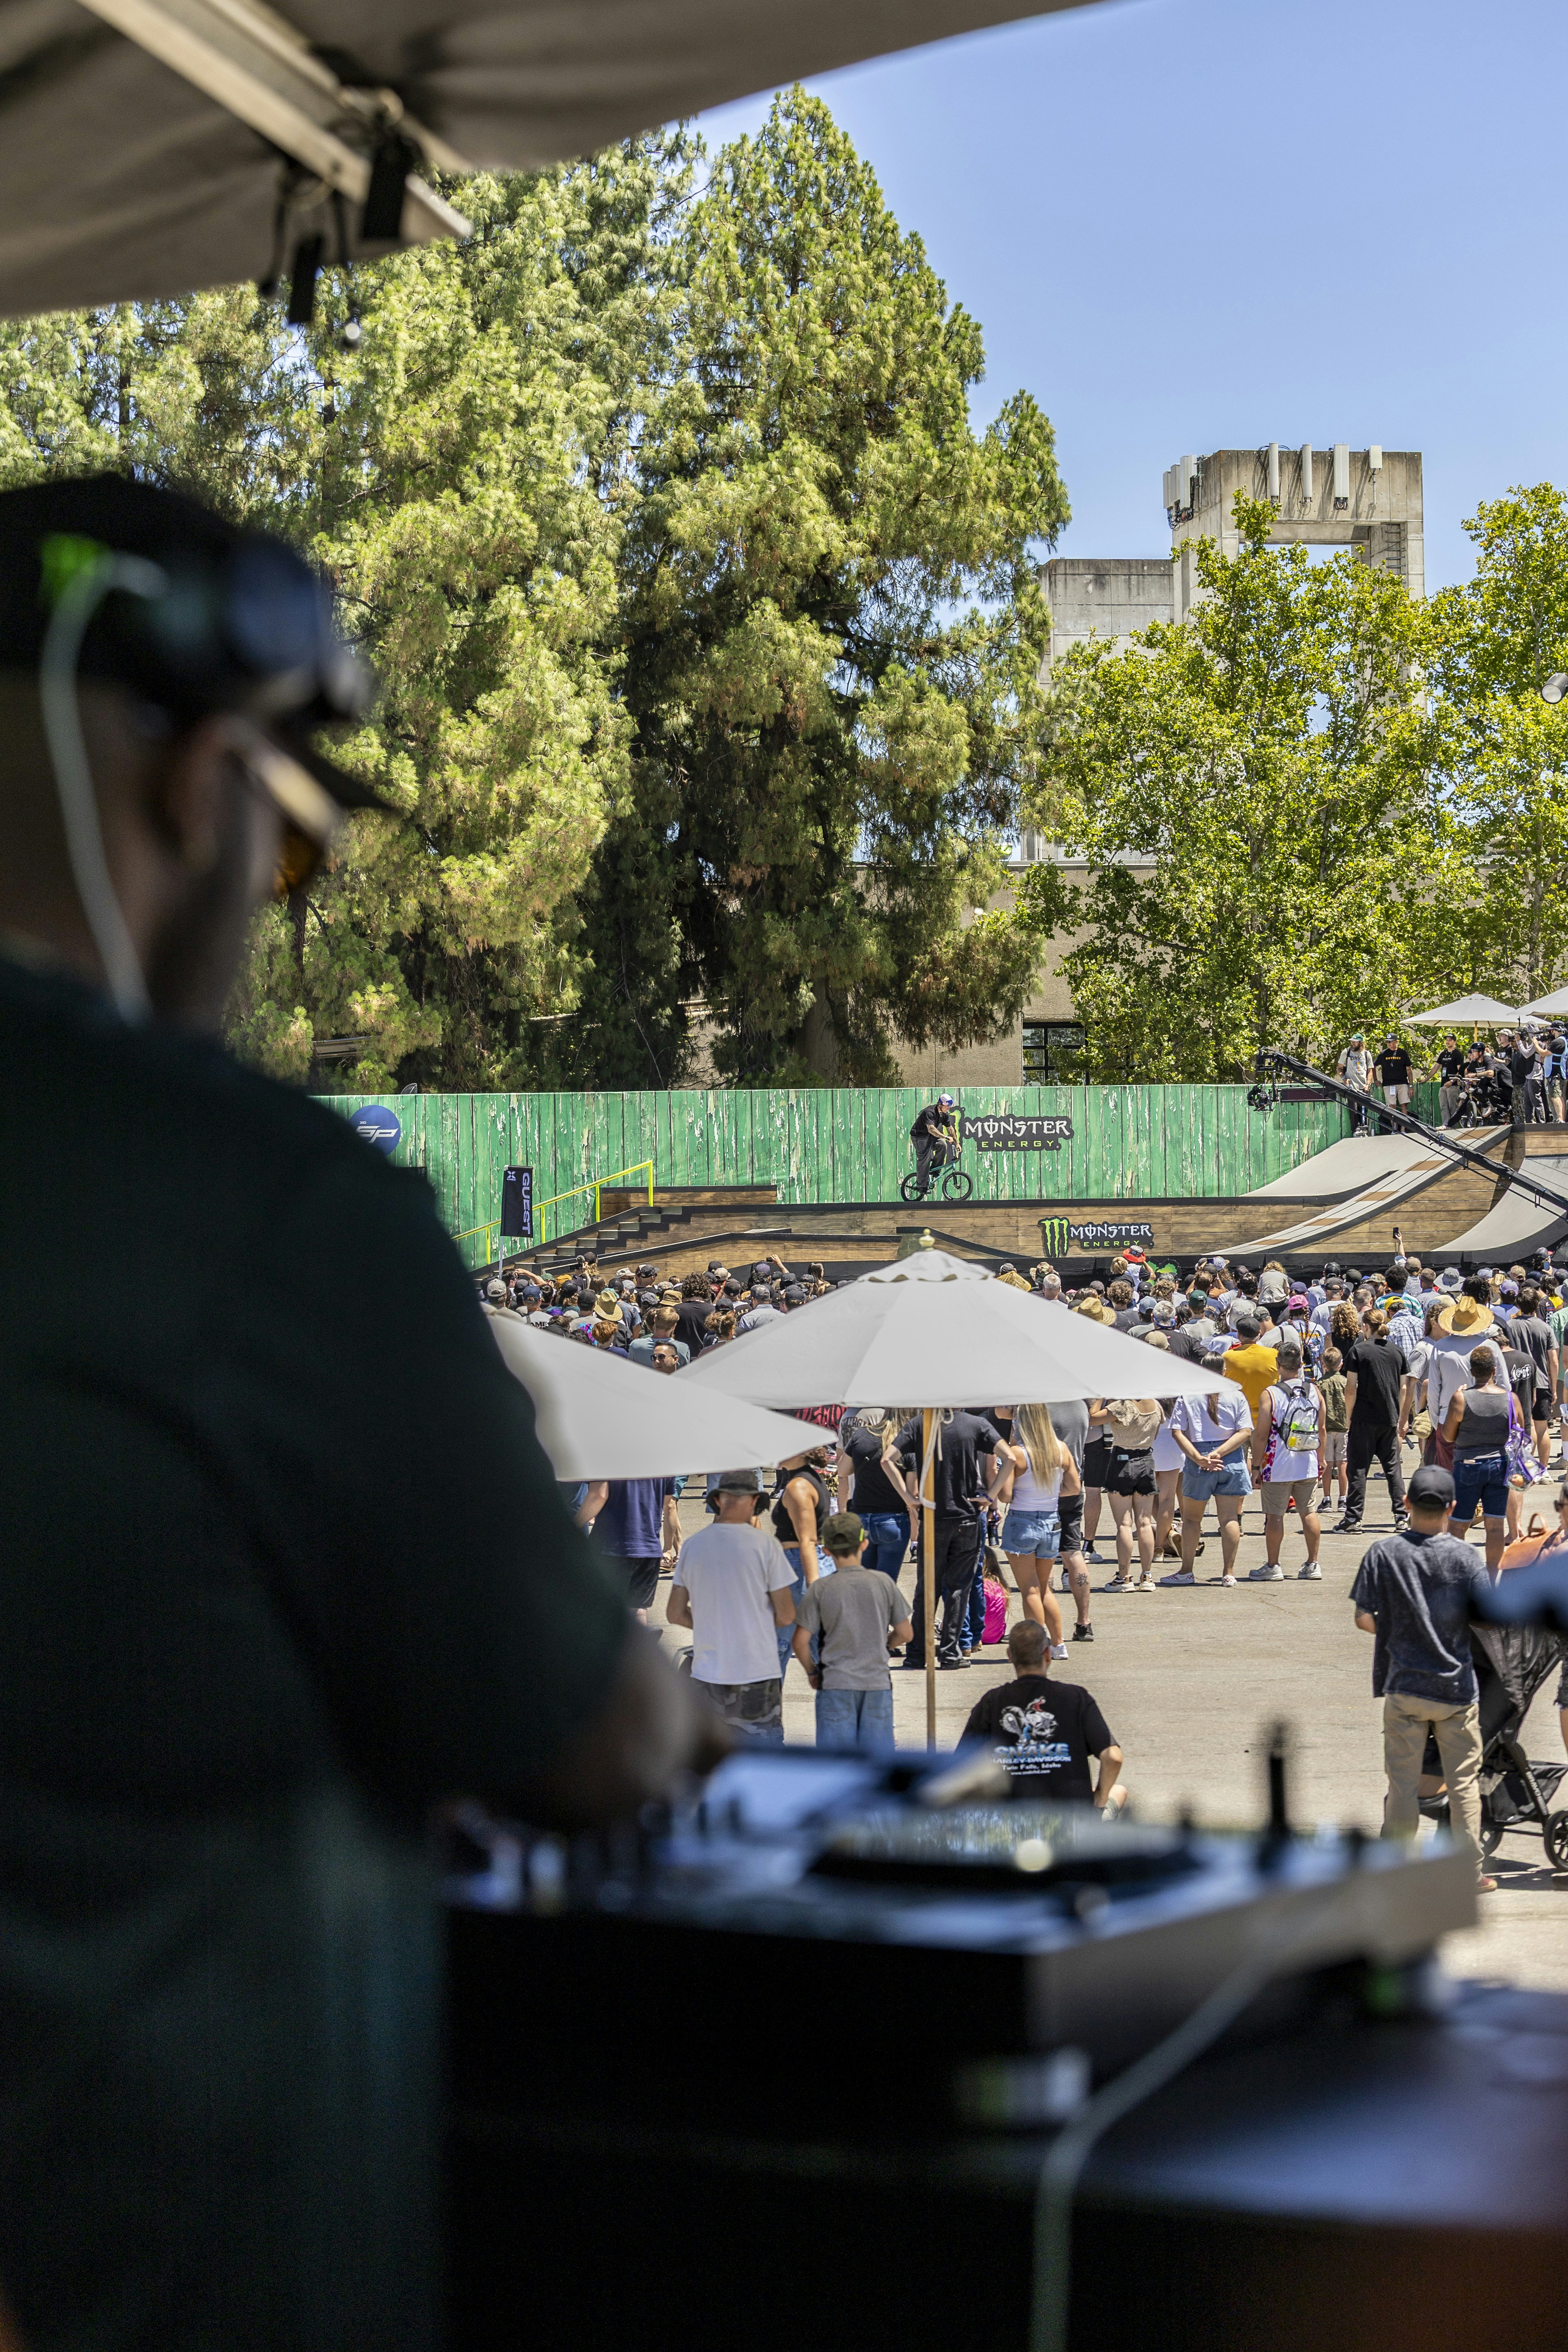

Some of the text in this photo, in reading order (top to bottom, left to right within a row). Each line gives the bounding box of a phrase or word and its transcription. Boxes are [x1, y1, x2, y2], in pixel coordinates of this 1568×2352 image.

[965, 1118, 1070, 1138] MONSTER
[522, 1173, 531, 1234] GUEST
[1070, 1223, 1152, 1240] MONSTER
[993, 1743, 1070, 1759] SNAKE
[1525, 1771, 1542, 1797] BRAVO
